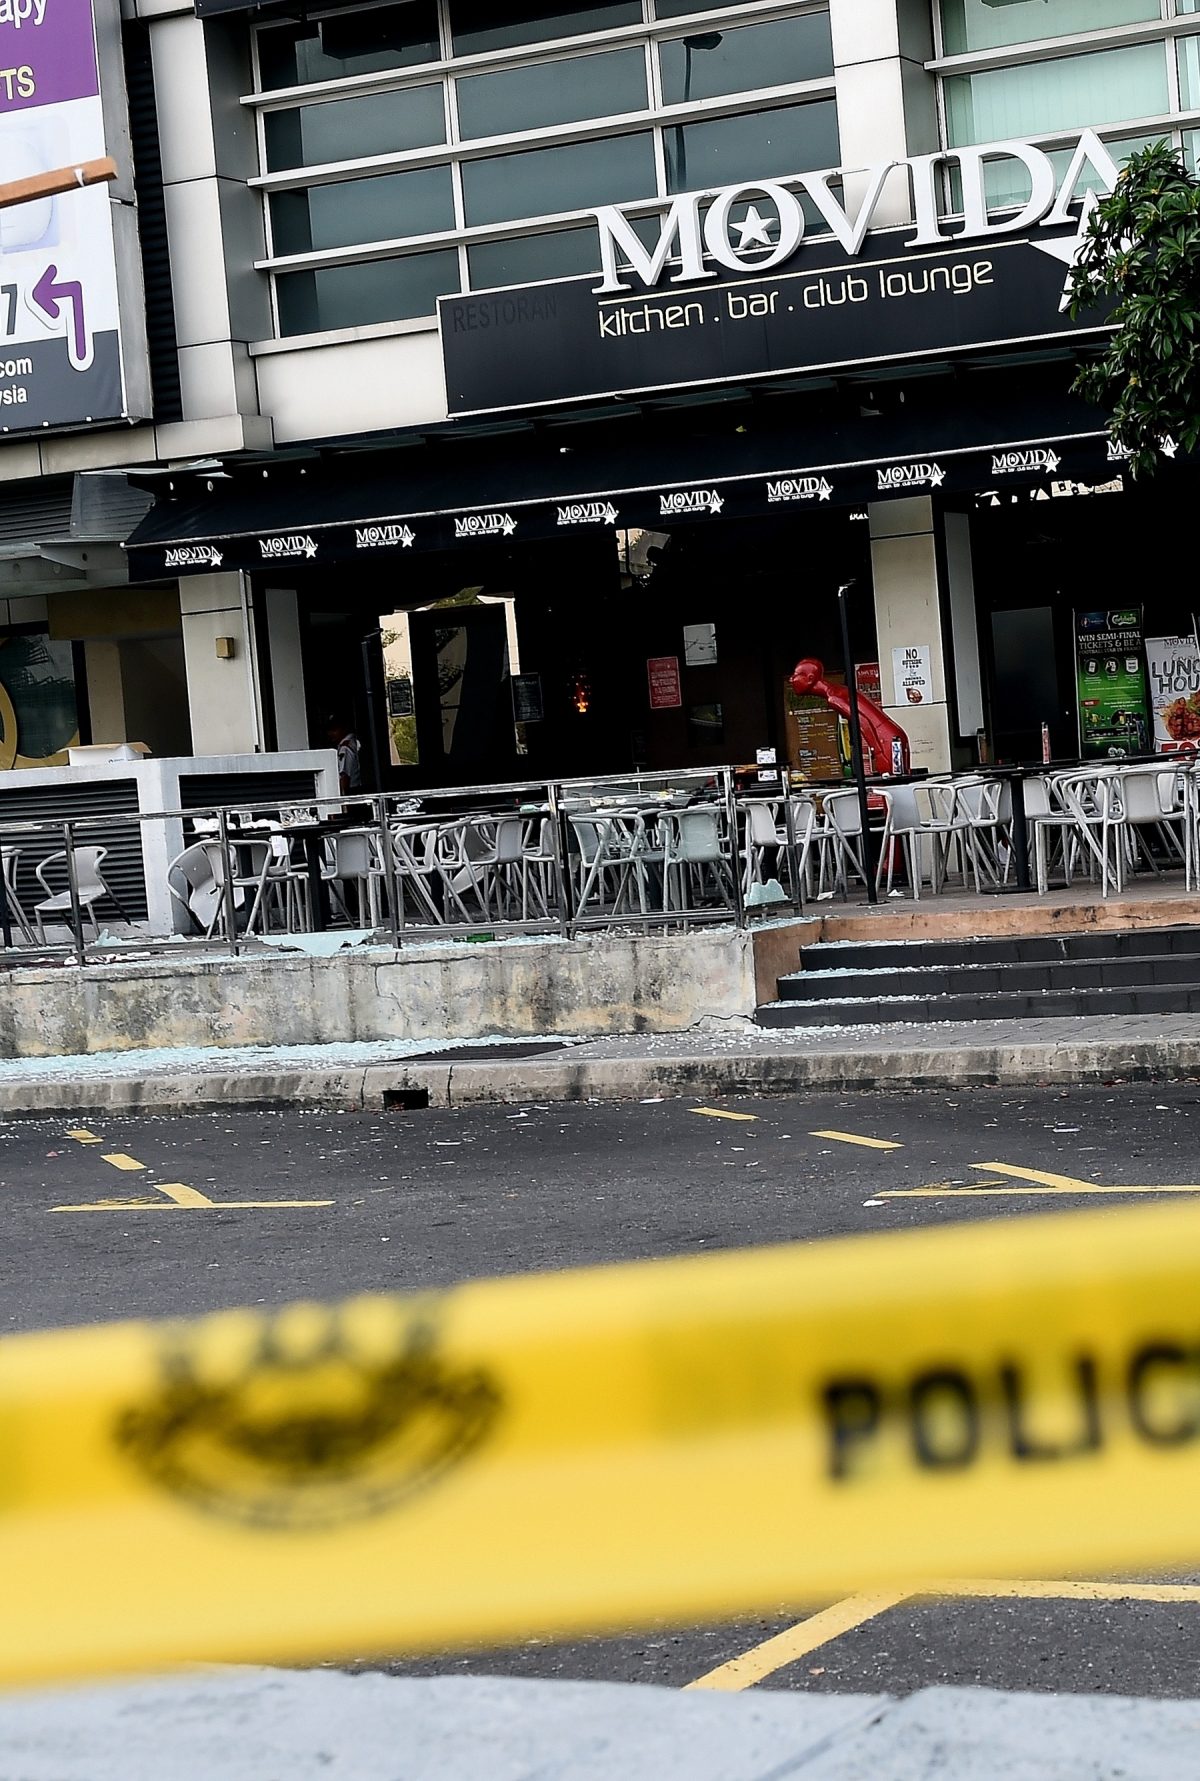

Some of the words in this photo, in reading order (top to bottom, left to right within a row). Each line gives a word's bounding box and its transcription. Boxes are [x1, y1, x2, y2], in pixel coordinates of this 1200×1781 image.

[588, 127, 1121, 294] MOVIDA
[598, 301, 704, 338] kitchen
[728, 290, 780, 319] bar
[803, 274, 869, 309] club
[879, 259, 995, 298] lounge
[453, 296, 558, 333] RESTORAN
[1078, 634, 1095, 642] WIN
[1097, 631, 1141, 641] SEMI-FINAL
[1163, 637, 1197, 646] MOVID
[1079, 640, 1114, 650] TICKETS
[905, 648, 918, 660] NO
[1159, 674, 1200, 694] HOU
